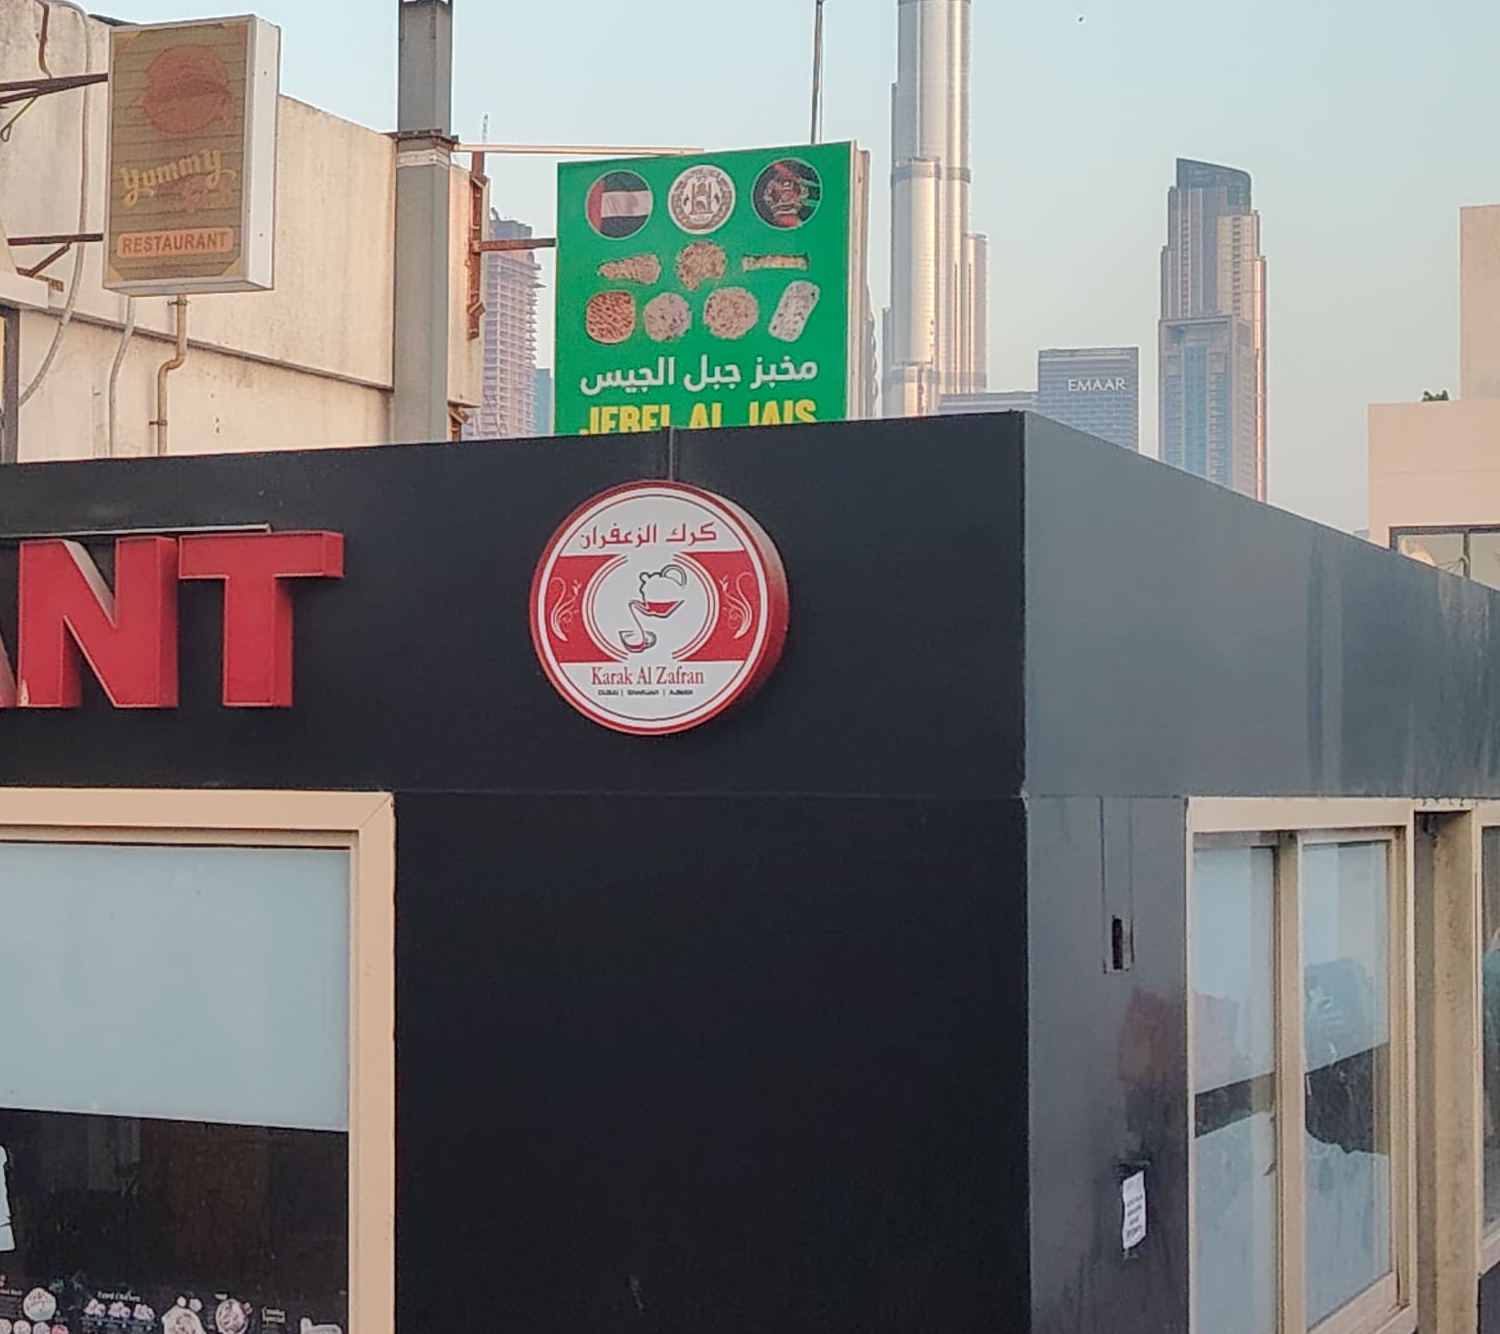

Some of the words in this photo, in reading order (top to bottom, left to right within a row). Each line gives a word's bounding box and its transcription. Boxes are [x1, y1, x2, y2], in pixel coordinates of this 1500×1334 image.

[122, 232, 229, 254] RESTAURANT
[683, 354, 741, 392] جبل
[750, 355, 819, 389] مخبز
[1067, 378, 1127, 392] EMAAR
[579, 523, 657, 549] الزعفران
[665, 522, 717, 546] كرك
[591, 667, 633, 685] Karak
[637, 667, 652, 685] Al
[655, 667, 704, 684] Zafran
